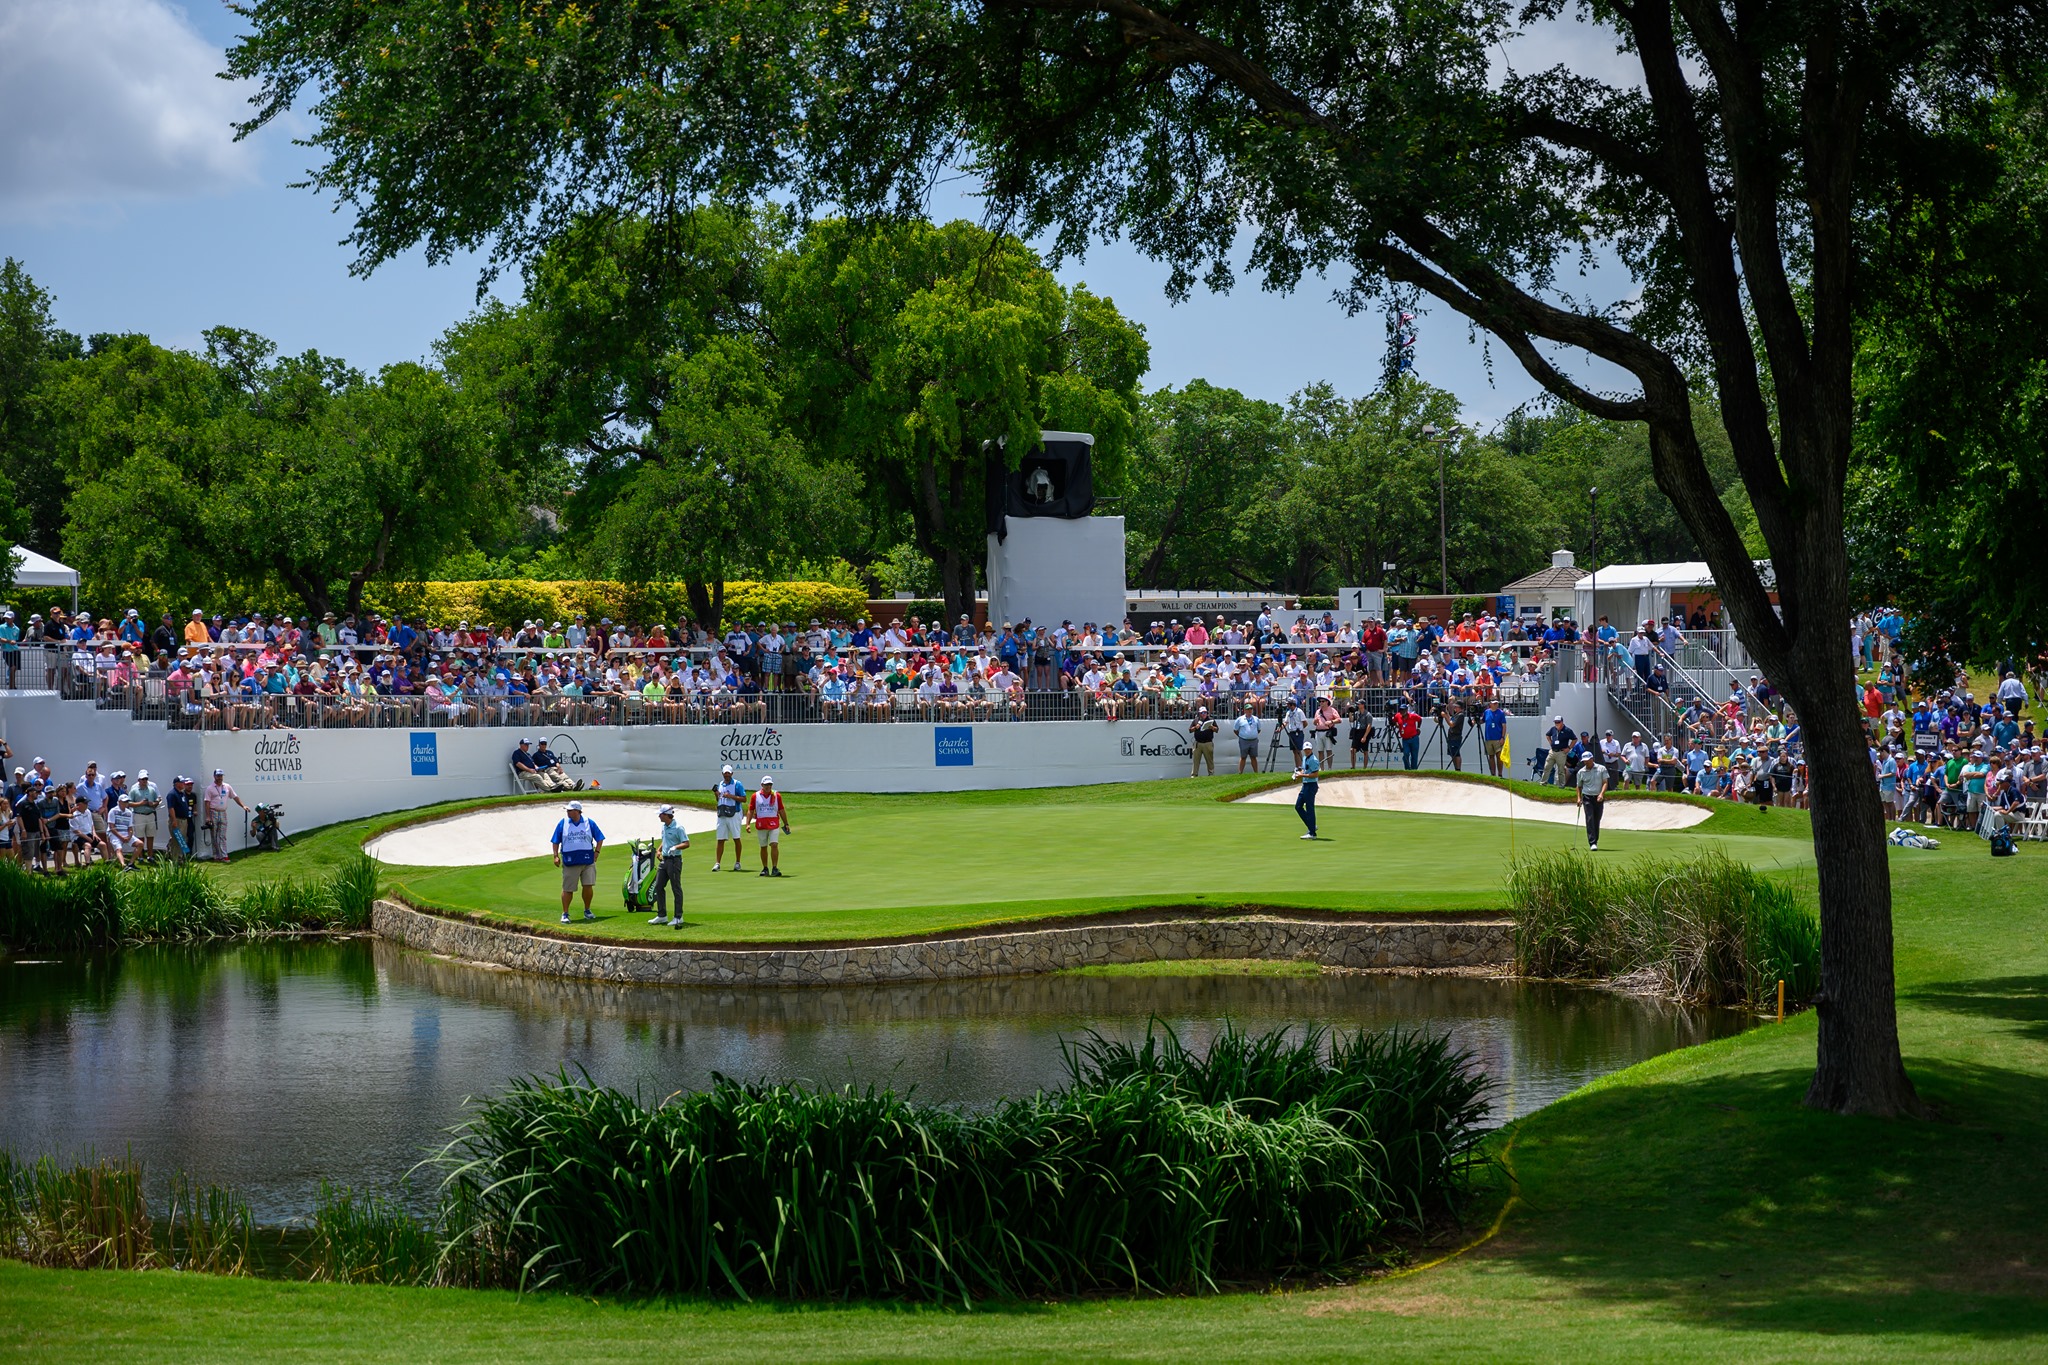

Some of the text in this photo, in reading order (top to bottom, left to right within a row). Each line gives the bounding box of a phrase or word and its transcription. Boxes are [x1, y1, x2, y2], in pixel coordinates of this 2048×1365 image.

[1353, 590, 1361, 608] 1
[1196, 602, 1237, 610] CHAMPIONS
[720, 727, 782, 747] charles
[938, 737, 969, 747] charles
[254, 733, 301, 755] charles
[412, 743, 434, 755] charles
[720, 749, 783, 762] SCHWAB
[1140, 744, 1193, 759] FedExCup
[254, 758, 302, 772] SCHWAB
[412, 755, 435, 763] SCHWAB
